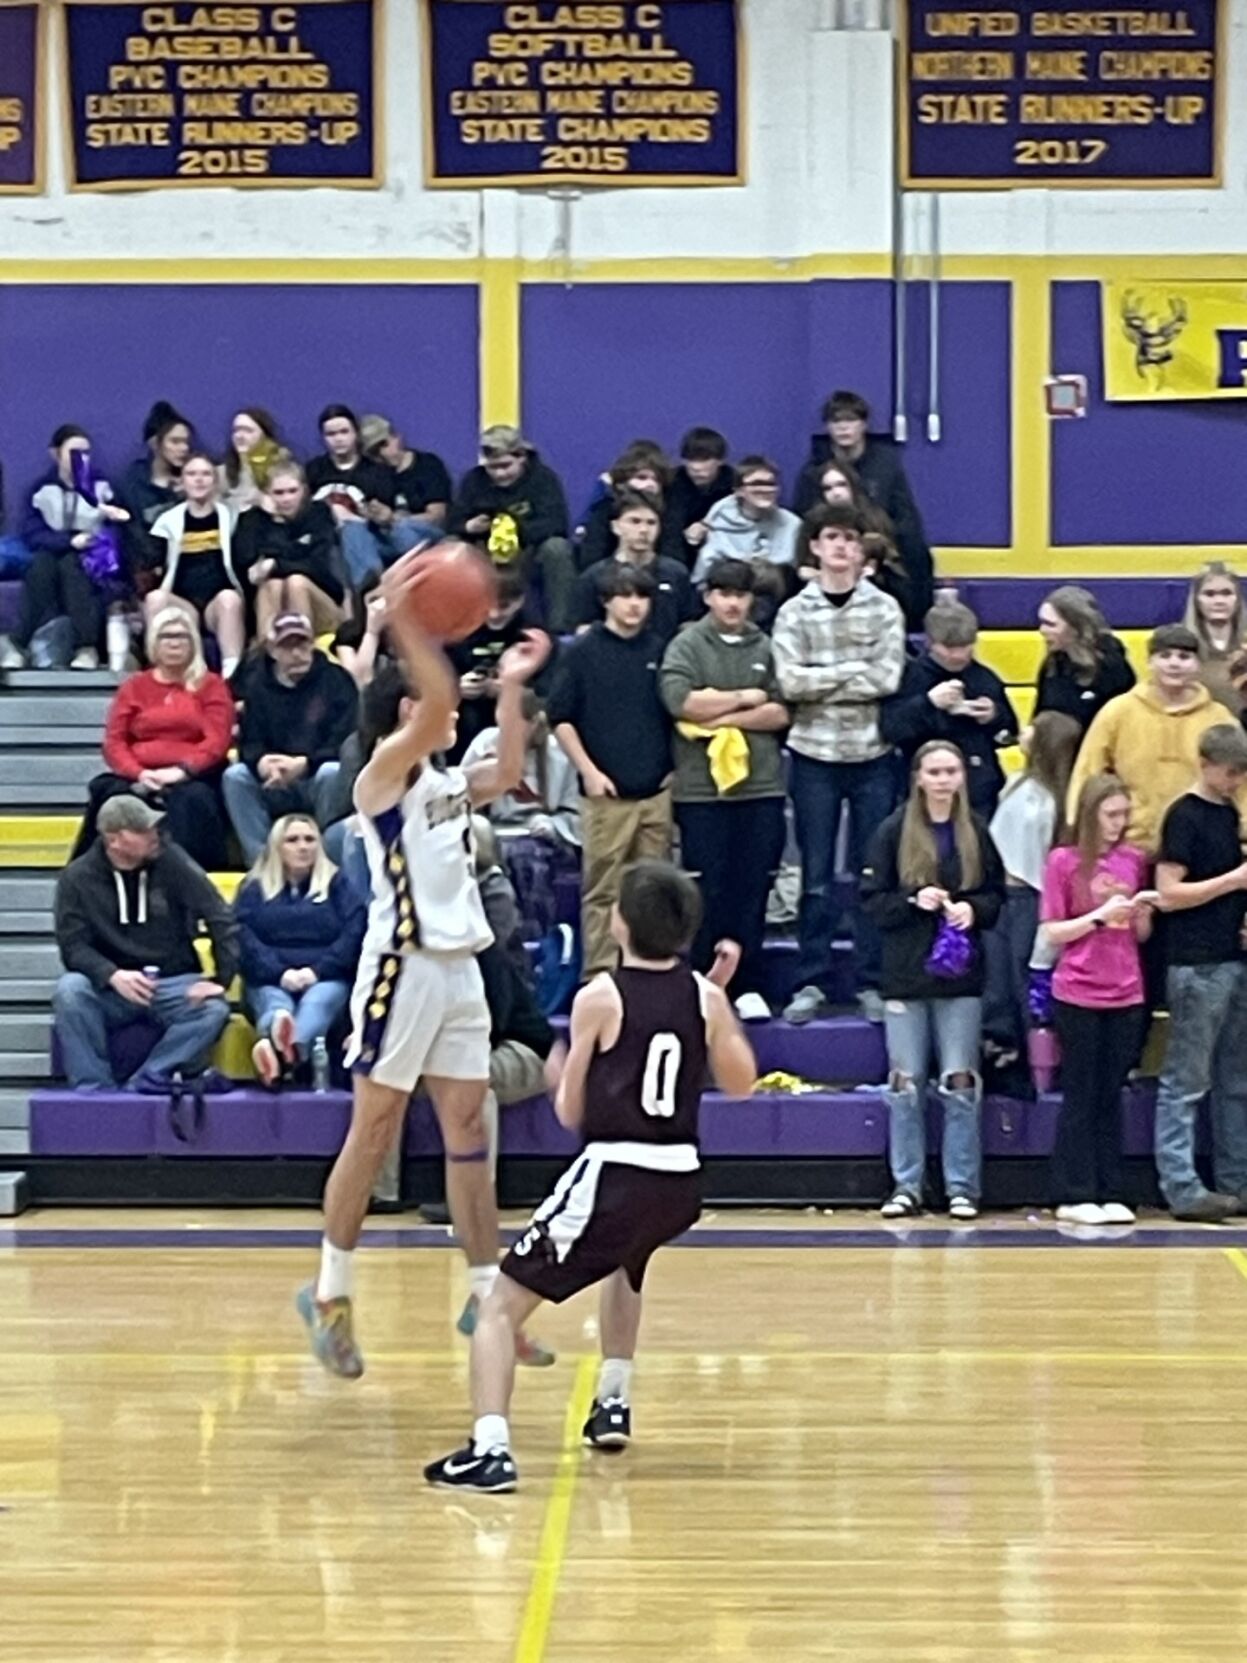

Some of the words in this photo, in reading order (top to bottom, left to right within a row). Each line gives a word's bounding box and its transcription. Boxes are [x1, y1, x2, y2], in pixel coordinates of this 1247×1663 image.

[142, 8, 260, 32] CLASS
[271, 8, 296, 31] C
[505, 5, 624, 30] CLASS
[635, 5, 661, 28] C
[926, 12, 1019, 37] UNIFIED
[1031, 12, 1195, 37] BASKETBALL
[126, 36, 314, 60] BASEBALL
[488, 33, 678, 57] SOFTBALL
[178, 64, 329, 88] CHAMPIONS
[540, 61, 693, 85] CHAMPIONS
[917, 95, 1009, 124] STATE
[1019, 94, 1205, 124] RUNNERS-UP
[86, 123, 171, 147] STATE
[181, 121, 361, 146] RUNNERS-UP
[460, 119, 545, 143] STATE
[557, 118, 711, 143] CHAMPIONS
[177, 150, 270, 175] 2015
[540, 147, 629, 171] 2015
[1014, 140, 1108, 164] 2017
[641, 1033, 682, 1117] 0
